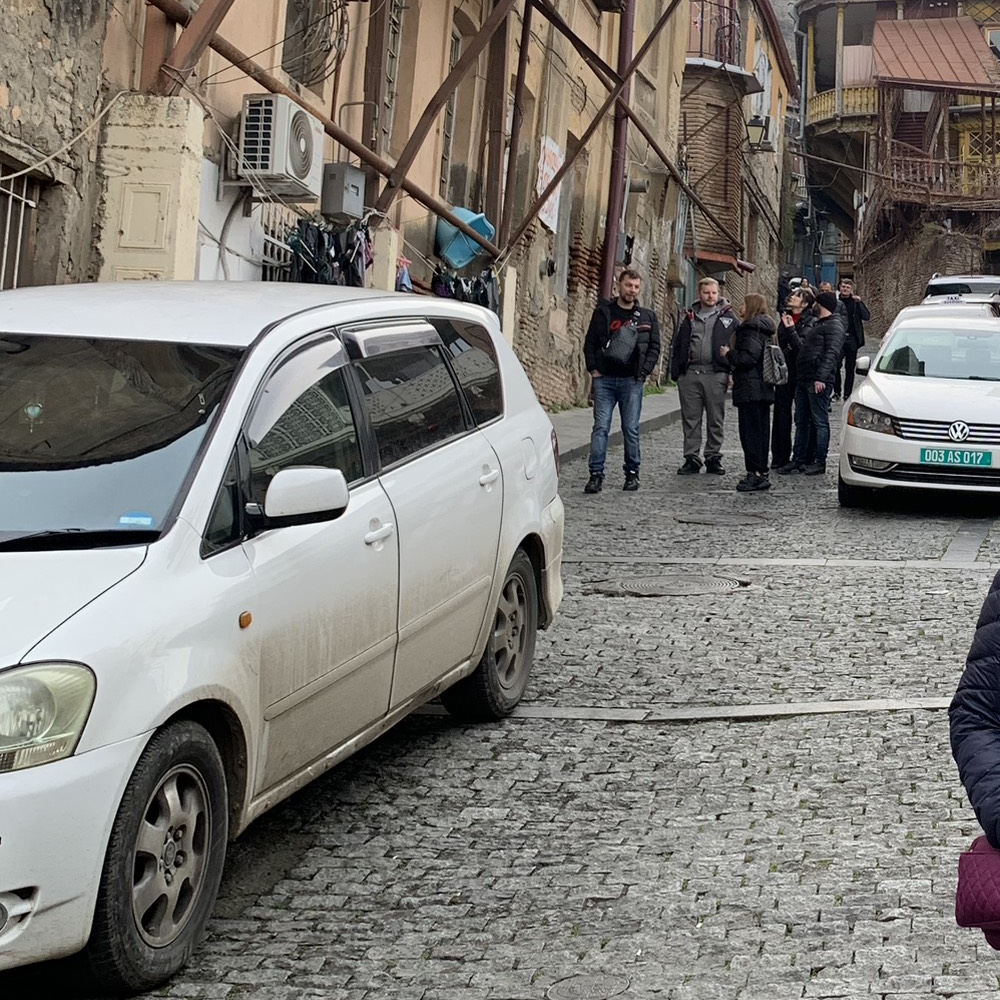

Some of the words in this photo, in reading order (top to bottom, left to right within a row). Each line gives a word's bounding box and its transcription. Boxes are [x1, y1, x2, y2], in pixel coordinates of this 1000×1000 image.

[949, 421, 969, 441] VW
[925, 449, 945, 463] 003
[947, 450, 961, 463] AS
[963, 451, 984, 465] 017
